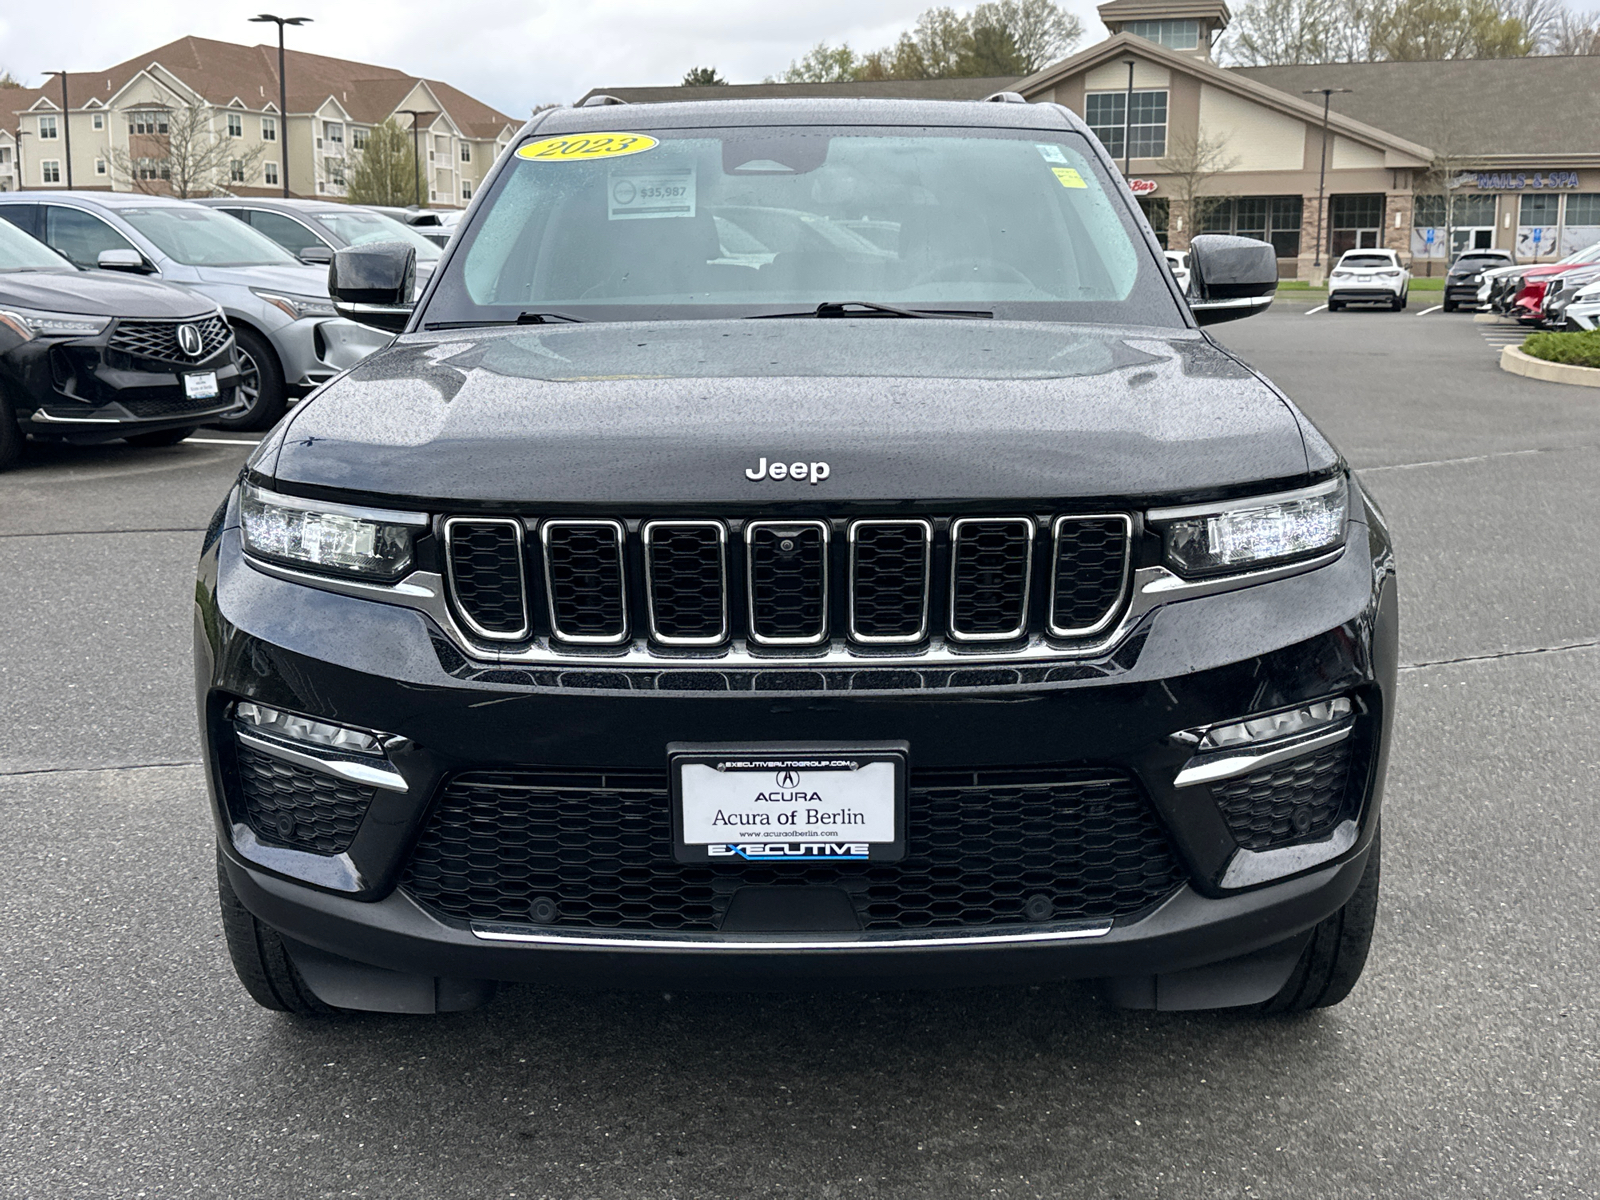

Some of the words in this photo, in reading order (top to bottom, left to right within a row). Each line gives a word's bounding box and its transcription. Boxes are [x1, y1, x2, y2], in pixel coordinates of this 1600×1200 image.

[534, 137, 638, 157] 2023
[1131, 179, 1155, 191] Bar
[1477, 173, 1526, 189] NAILS
[1532, 173, 1543, 188] &
[1548, 172, 1579, 188] SPA
[640, 187, 686, 199] $35,987
[745, 457, 830, 484] Jeep
[725, 760, 850, 768] EXECUTIVEAUTOGROUP.COM
[754, 792, 823, 802] ACURA
[712, 809, 771, 825] Acura
[777, 810, 798, 825] of
[805, 808, 866, 825] Berlin
[739, 830, 839, 838] www.acuraofberlin.com
[708, 843, 870, 857] EXECUTIVE
